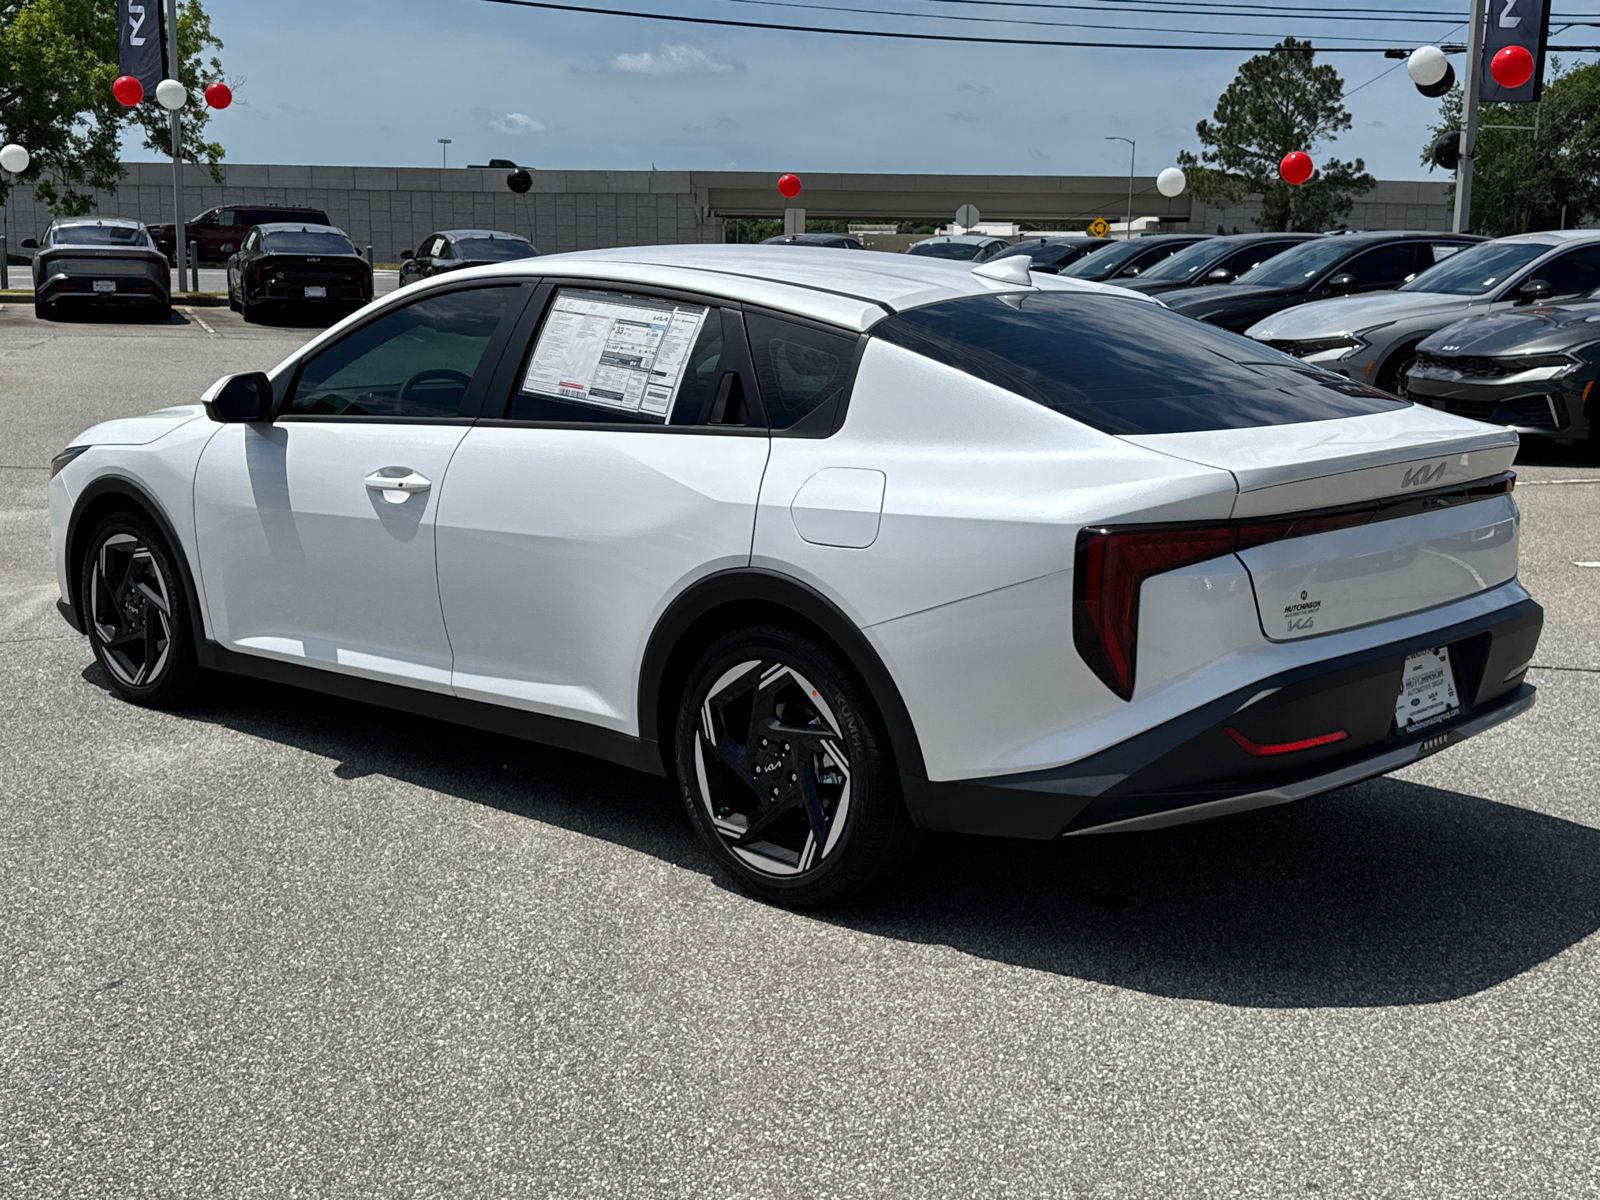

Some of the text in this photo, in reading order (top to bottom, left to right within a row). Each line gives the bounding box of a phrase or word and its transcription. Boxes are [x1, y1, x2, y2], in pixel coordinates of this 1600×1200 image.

[615, 326, 625, 335] 33
[1401, 462, 1447, 488] KIA
[1284, 600, 1321, 613] HUTCHINSON
[1287, 617, 1313, 631] K4
[1405, 668, 1445, 690] HUTCHINSON
[1408, 678, 1444, 697] AUTOMOTIVE GROUP
[835, 692, 863, 760] KUMHO
[764, 760, 782, 773] KIA
